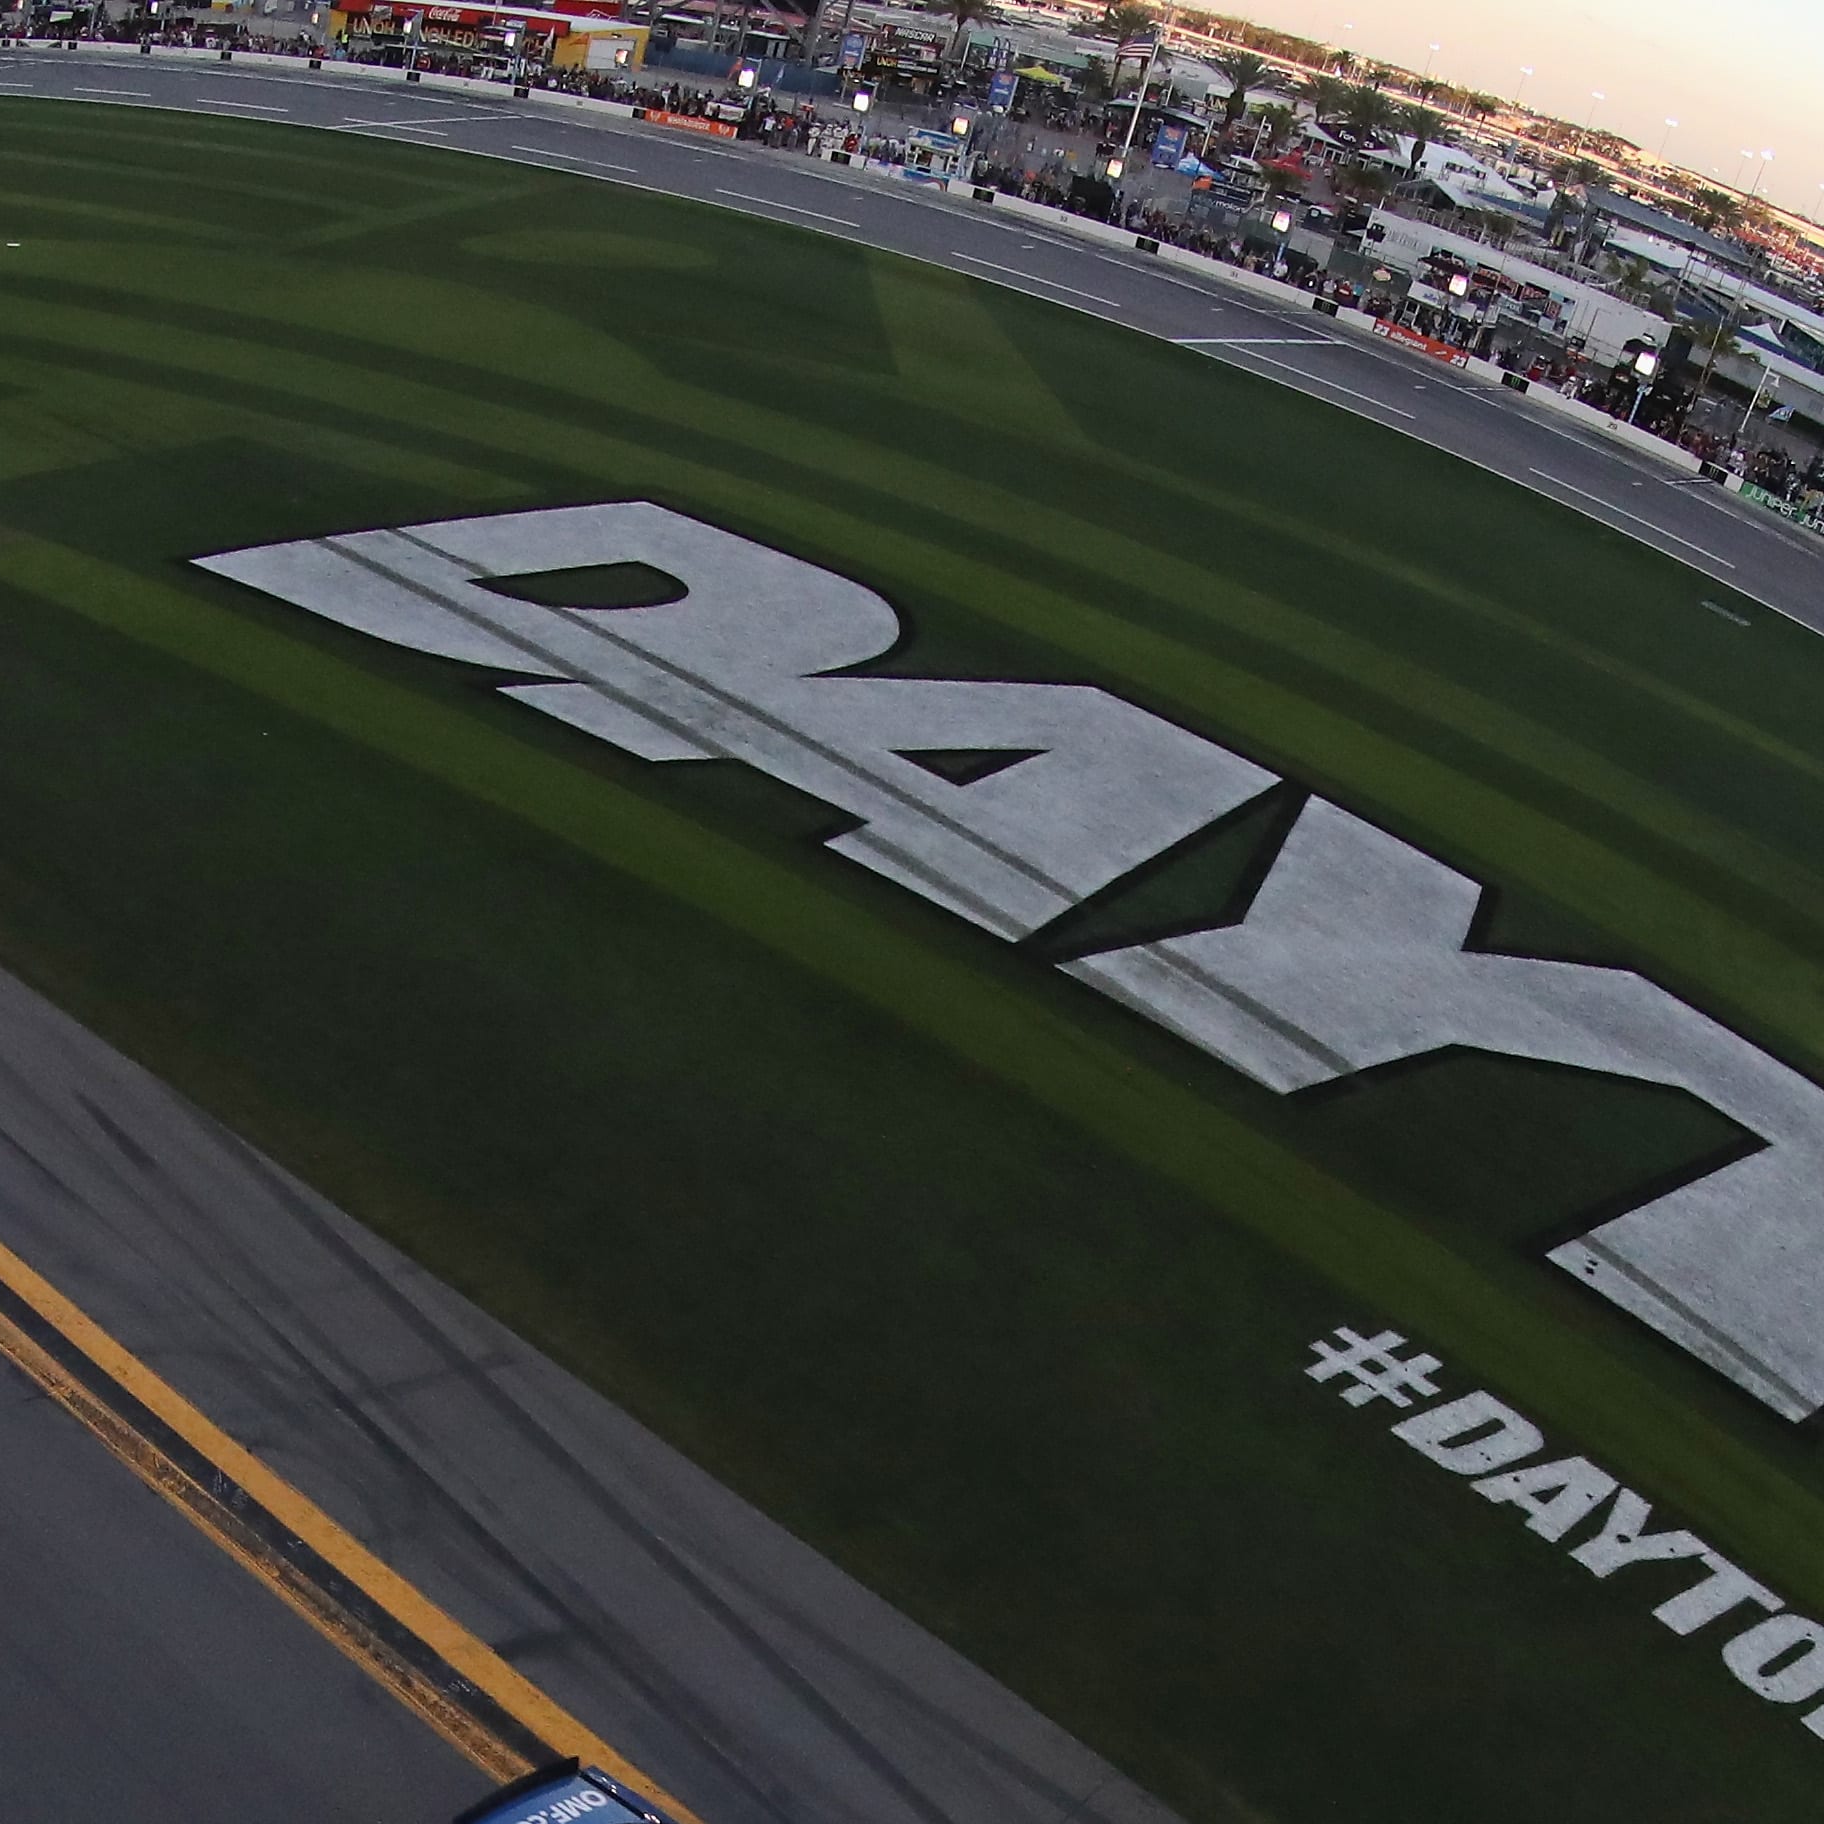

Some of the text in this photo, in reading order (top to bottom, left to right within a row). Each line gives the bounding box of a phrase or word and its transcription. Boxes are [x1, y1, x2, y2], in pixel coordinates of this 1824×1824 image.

[895, 27, 936, 43] NASCAR
[1374, 324, 1466, 367] 23 allegiant 23
